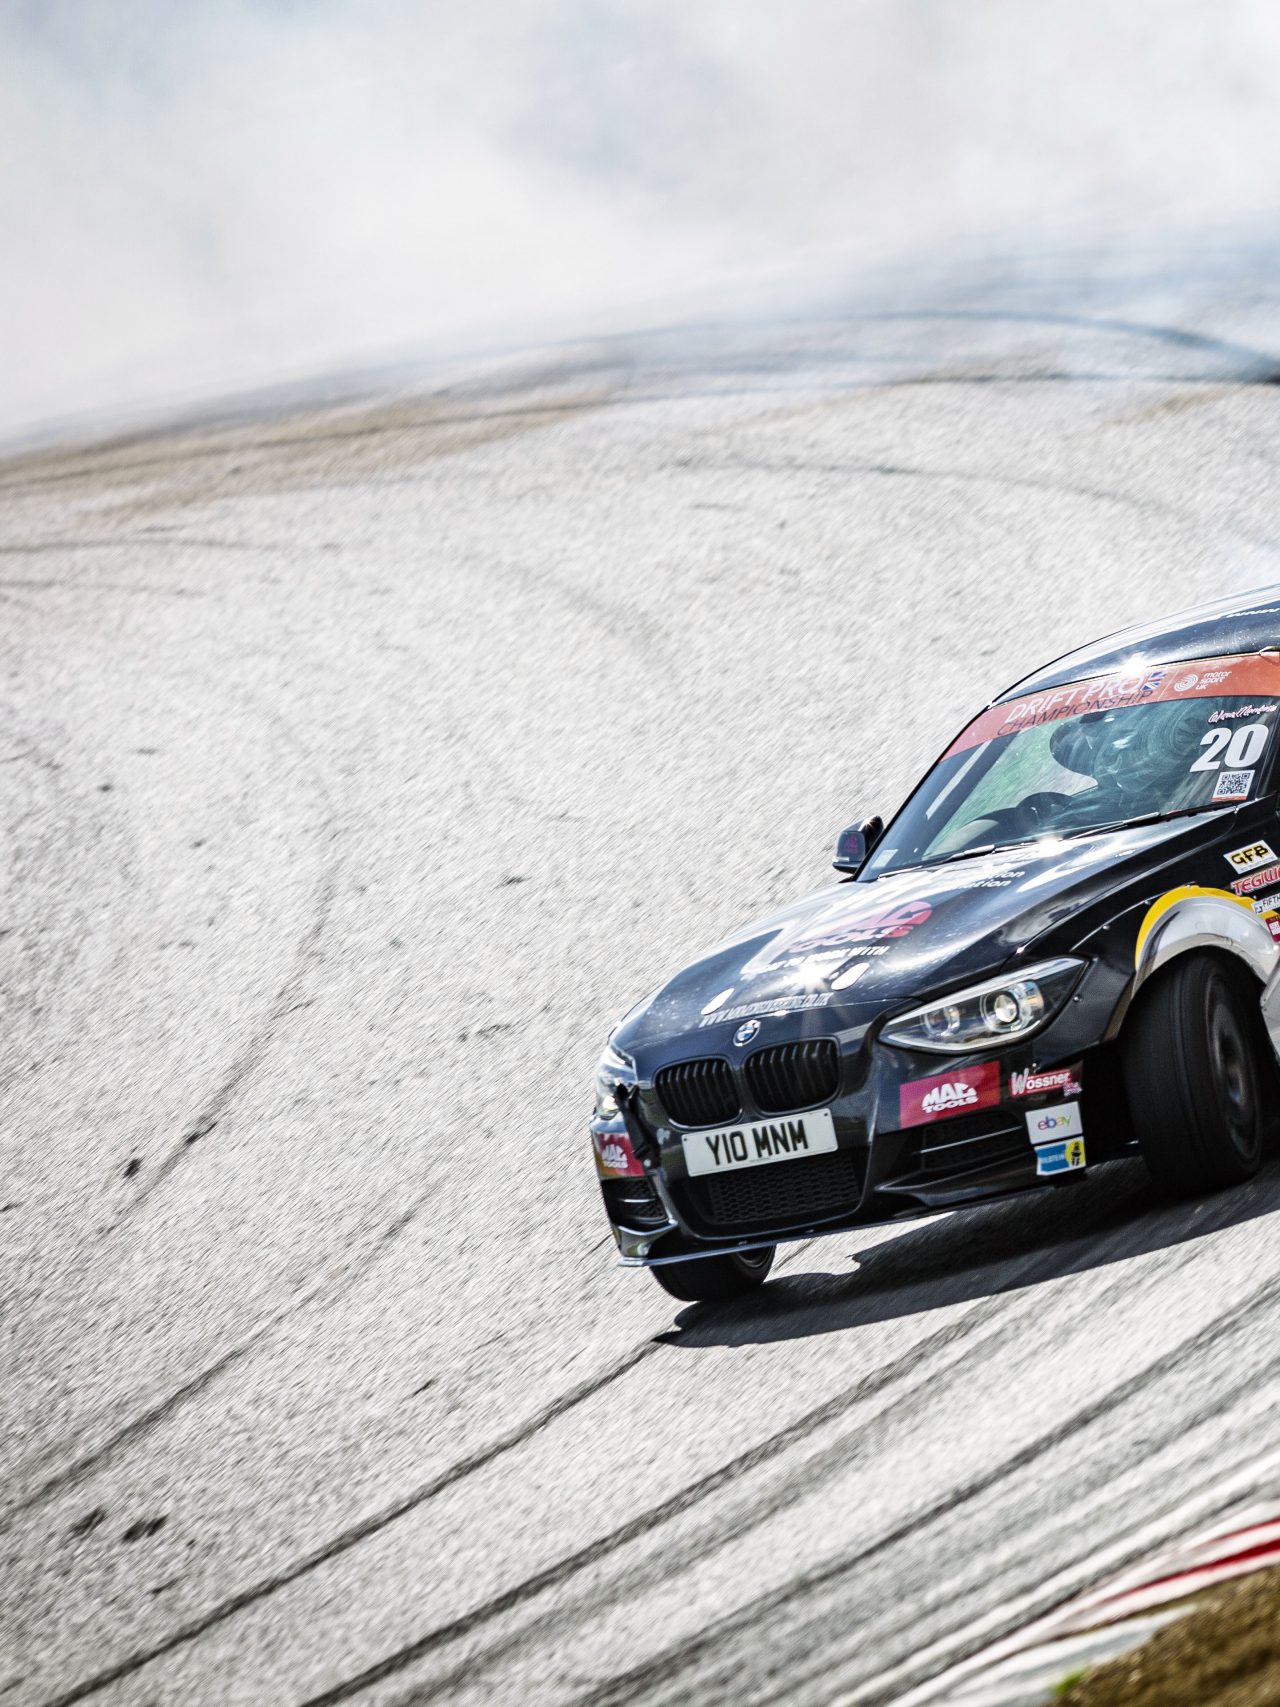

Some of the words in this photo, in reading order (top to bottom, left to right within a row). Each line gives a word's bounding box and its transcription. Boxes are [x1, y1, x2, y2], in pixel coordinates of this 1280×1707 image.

[1200, 677, 1226, 686] sport
[1204, 671, 1232, 679] motor
[1005, 687, 1087, 724] DRIFT
[1082, 673, 1144, 701] PRO
[997, 690, 1154, 736] CHAMPIONSHIP
[1189, 723, 1269, 773] 20
[1231, 845, 1269, 865] GFB
[922, 1082, 977, 1108] MAC
[922, 1096, 979, 1114] TOOLS
[1038, 1115, 1071, 1130] ebay
[706, 1131, 748, 1166] Y10
[752, 1119, 809, 1158] MNM
[602, 1144, 628, 1162] MAC
